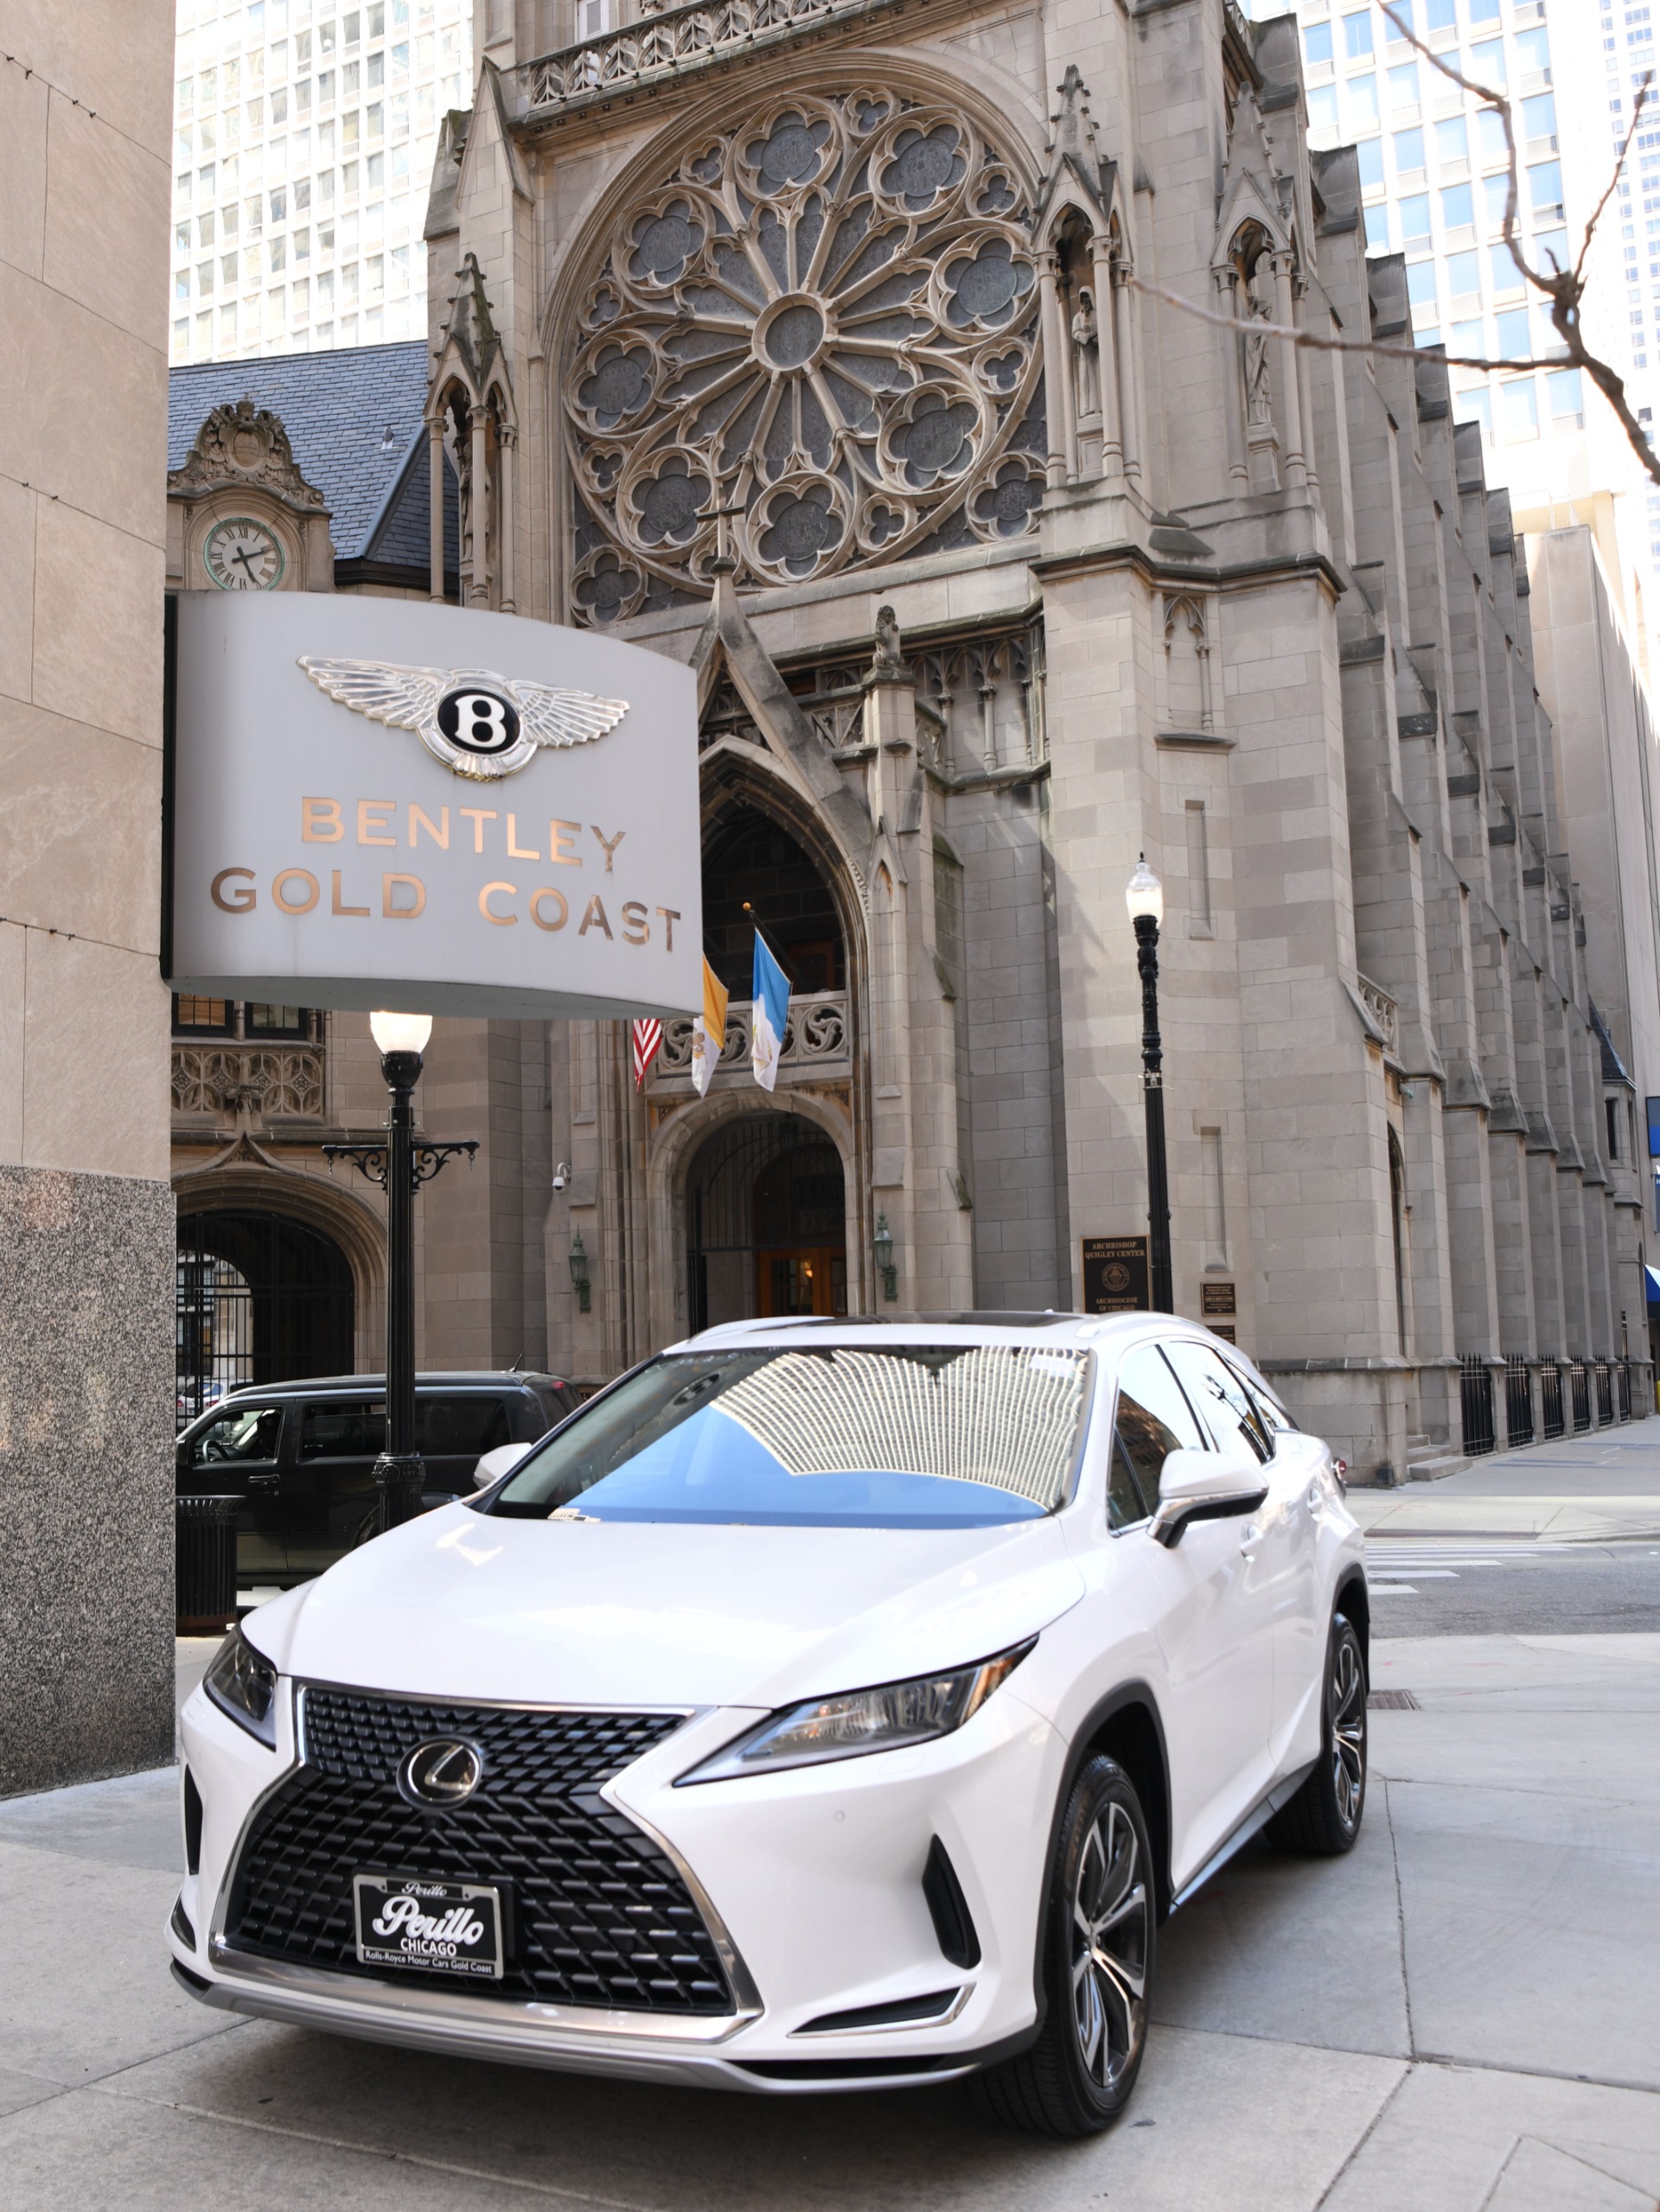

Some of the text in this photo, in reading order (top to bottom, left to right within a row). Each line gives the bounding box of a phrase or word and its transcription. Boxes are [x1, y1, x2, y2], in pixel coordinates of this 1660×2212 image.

[238, 526, 248, 539] XII
[454, 693, 508, 749] B
[302, 796, 626, 872] BENTLEY
[210, 867, 681, 953] GOLD COAST
[1085, 1249, 1145, 1259] QUIGLEY CENTER
[1092, 1241, 1138, 1250] ARCHBISHOP
[401, 1881, 447, 1897] Perillo
[372, 1895, 484, 1945] Perillo
[400, 1938, 456, 1957] CHICAGO
[365, 1950, 492, 1973] Rolls-Royce Motor Cars Gold Coast
